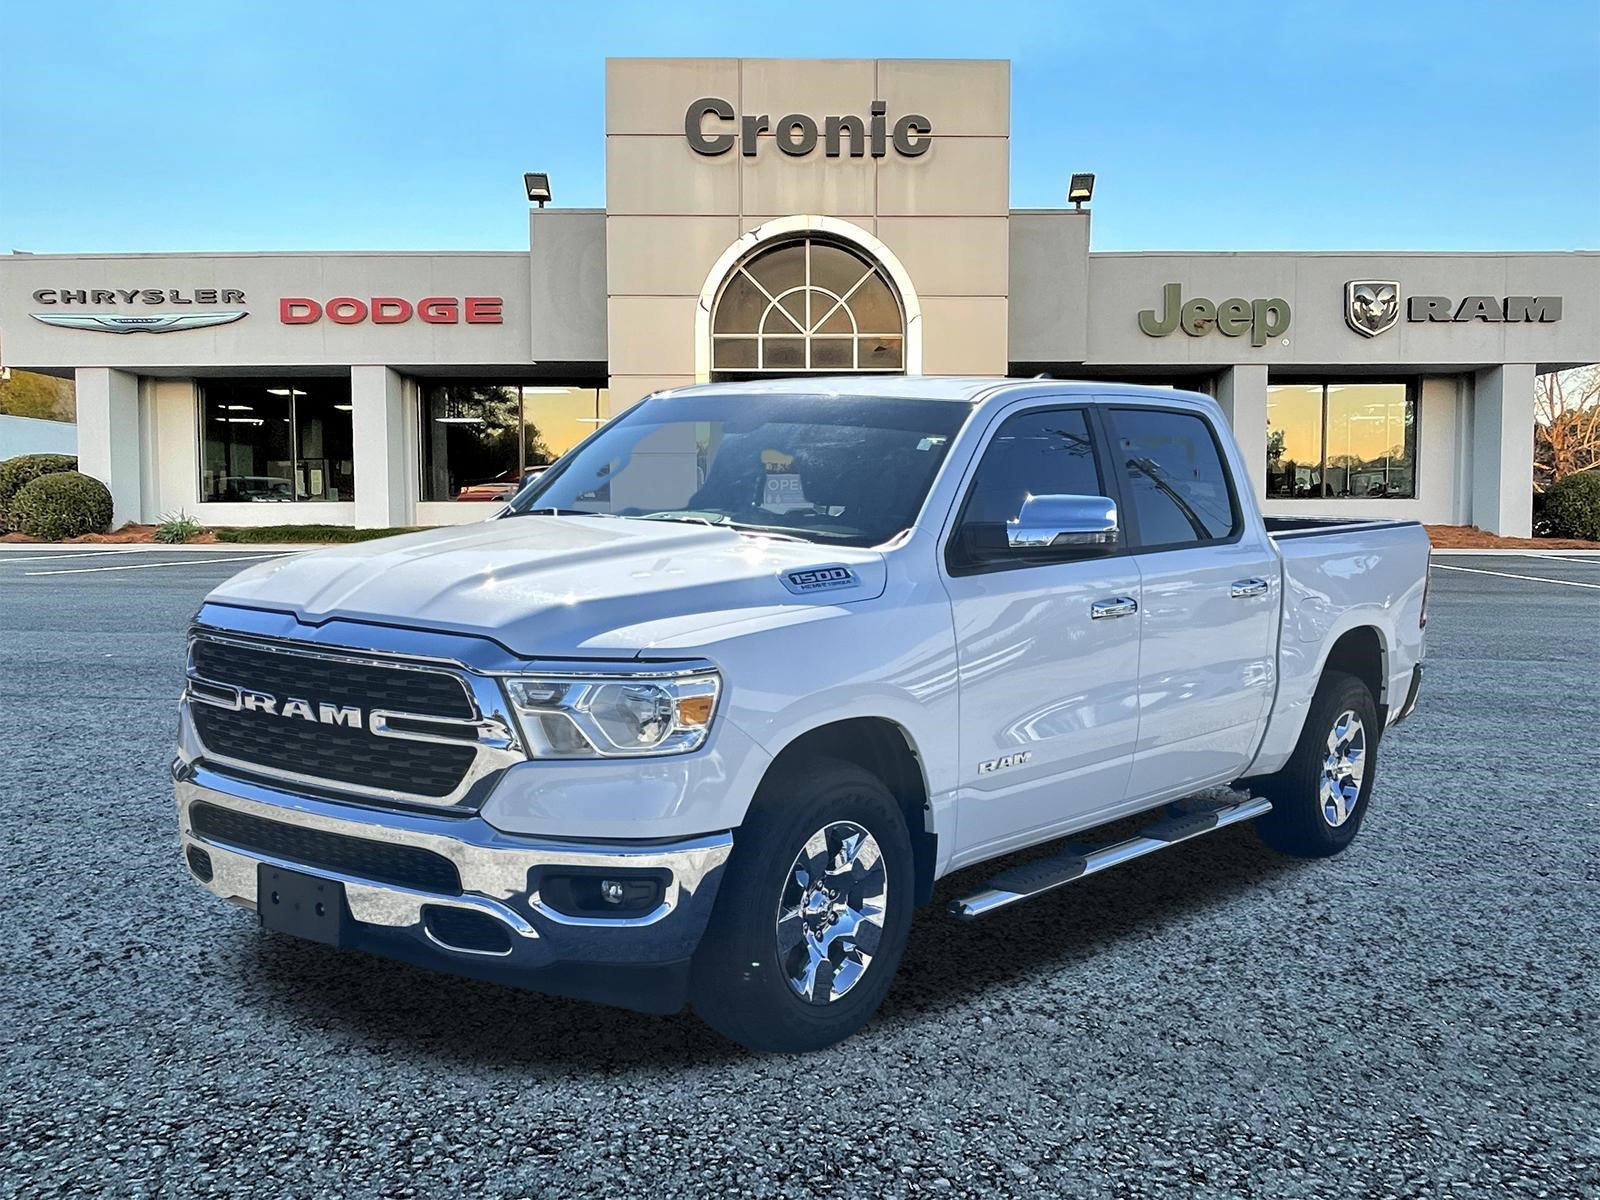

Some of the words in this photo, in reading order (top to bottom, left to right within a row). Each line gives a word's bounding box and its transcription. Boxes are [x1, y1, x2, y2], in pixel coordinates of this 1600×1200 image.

[685, 97, 932, 157] Cronic
[32, 289, 246, 304] CHRYSLER
[1407, 296, 1562, 322] RAM
[279, 297, 503, 324] DODGE
[1138, 283, 1291, 347] Jeep
[767, 479, 803, 491] OPE
[791, 569, 847, 585] 1500
[244, 690, 362, 728] RAM
[977, 750, 1032, 774] RAM
